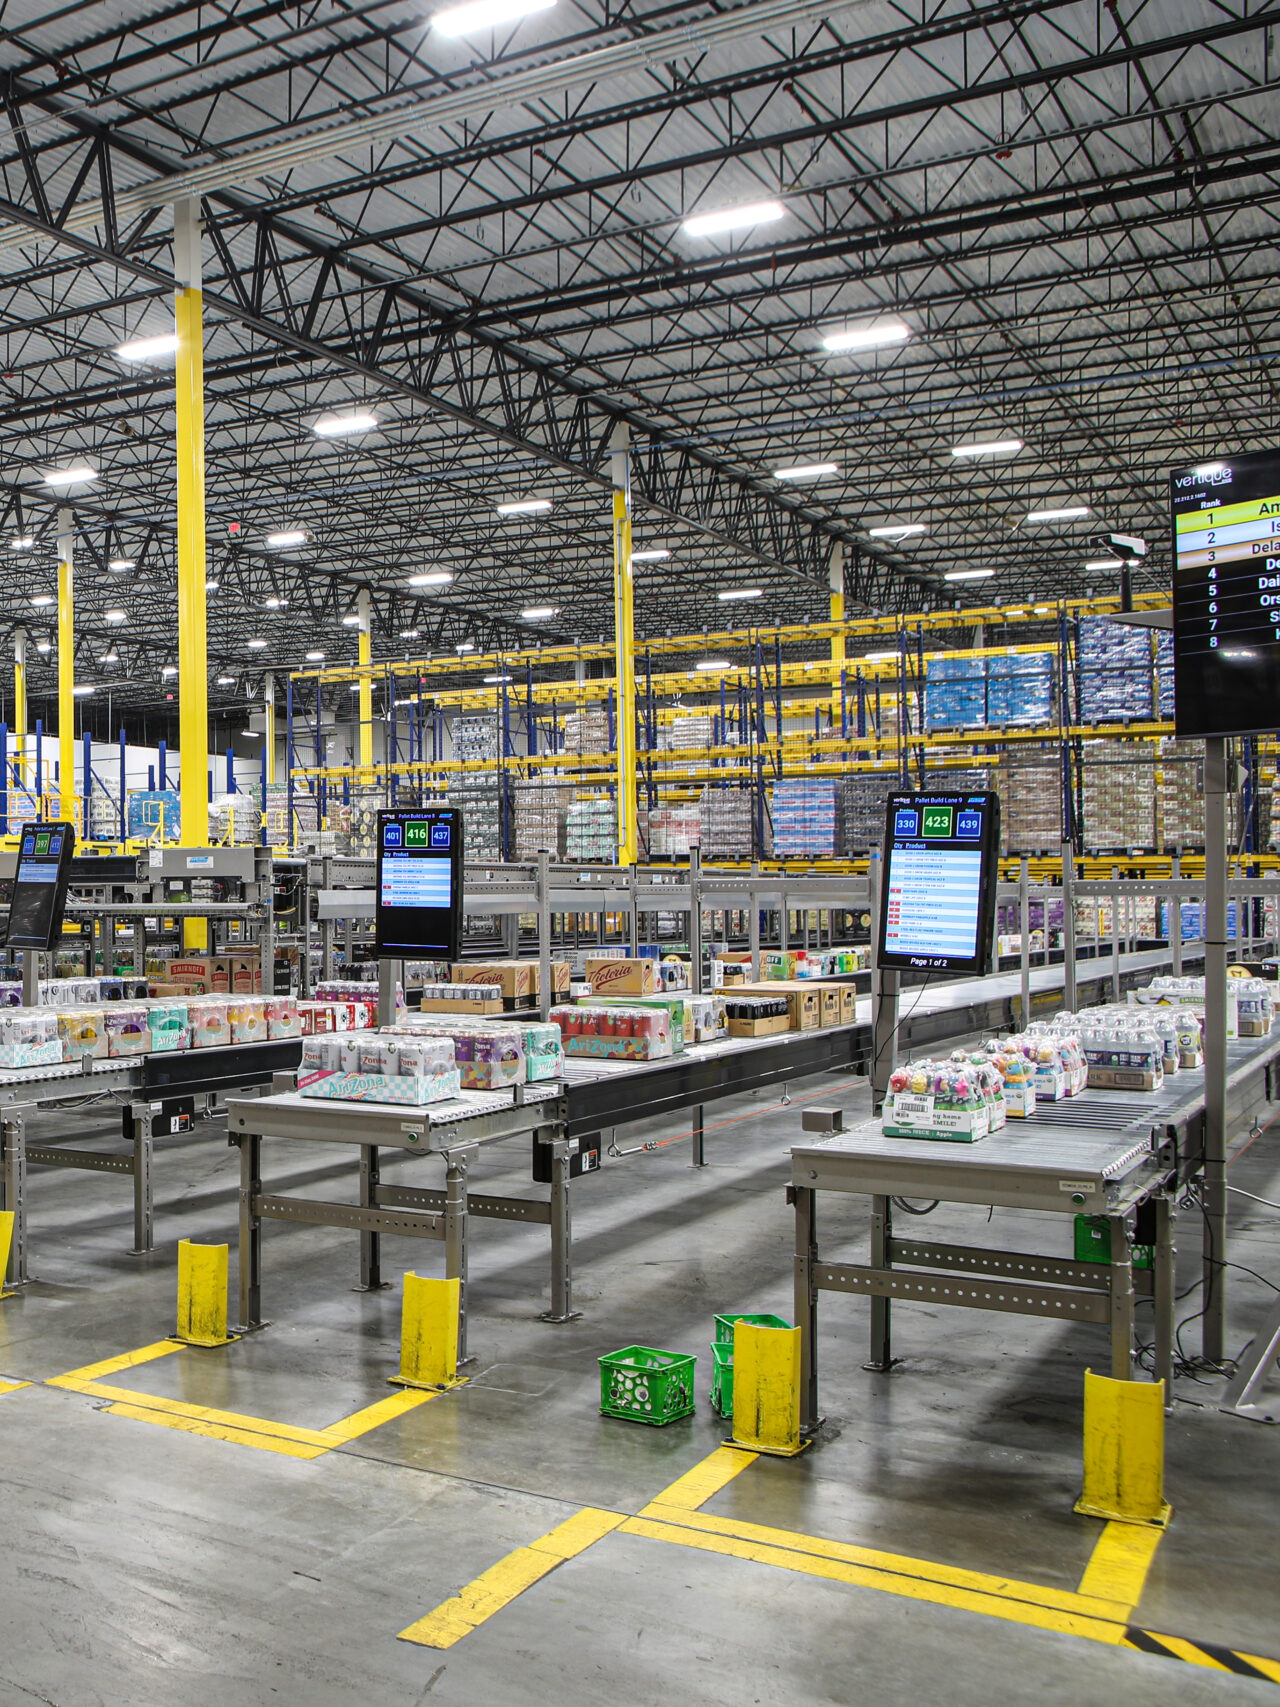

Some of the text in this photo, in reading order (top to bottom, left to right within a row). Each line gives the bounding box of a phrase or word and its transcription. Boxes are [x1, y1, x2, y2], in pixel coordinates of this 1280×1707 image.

[1200, 498, 1222, 510] Rank
[1207, 512, 1214, 525] 1
[1208, 532, 1216, 544] 2
[1208, 551, 1216, 562] 3
[1208, 568, 1217, 579] 4
[1208, 584, 1218, 596] 5
[1208, 602, 1218, 614] 6
[1208, 618, 1218, 630] 7
[1209, 636, 1218, 648] 8
[898, 820, 915, 828] 330
[925, 816, 949, 828] 423
[960, 820, 978, 828] 439
[408, 829, 426, 838] 416
[910, 958, 927, 966] Page
[589, 962, 632, 987] Victoria
[567, 1038, 624, 1054] AriZona
[328, 1076, 384, 1096] AriZona
